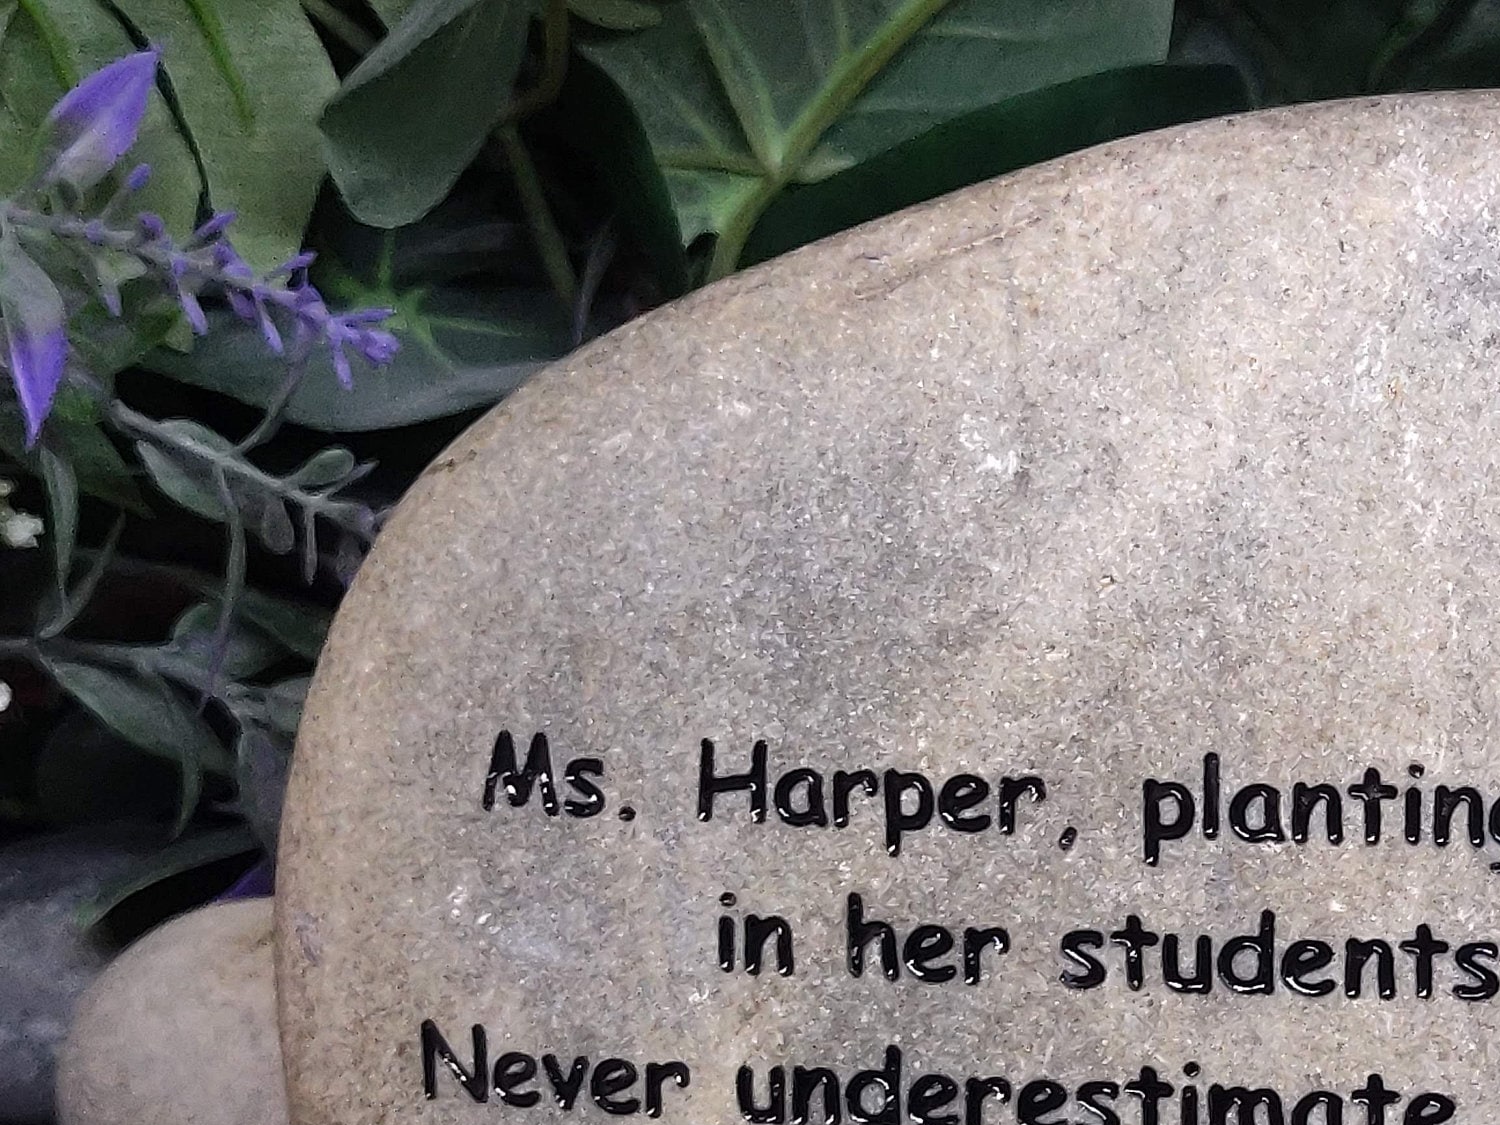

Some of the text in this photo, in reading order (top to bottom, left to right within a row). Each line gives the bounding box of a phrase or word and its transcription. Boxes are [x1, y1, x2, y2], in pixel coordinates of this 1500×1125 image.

[483, 731, 636, 822] Ms.
[717, 889, 794, 977] in
[847, 892, 1010, 986] her
[1060, 909, 1500, 1002] students
[420, 1019, 690, 1119] Never
